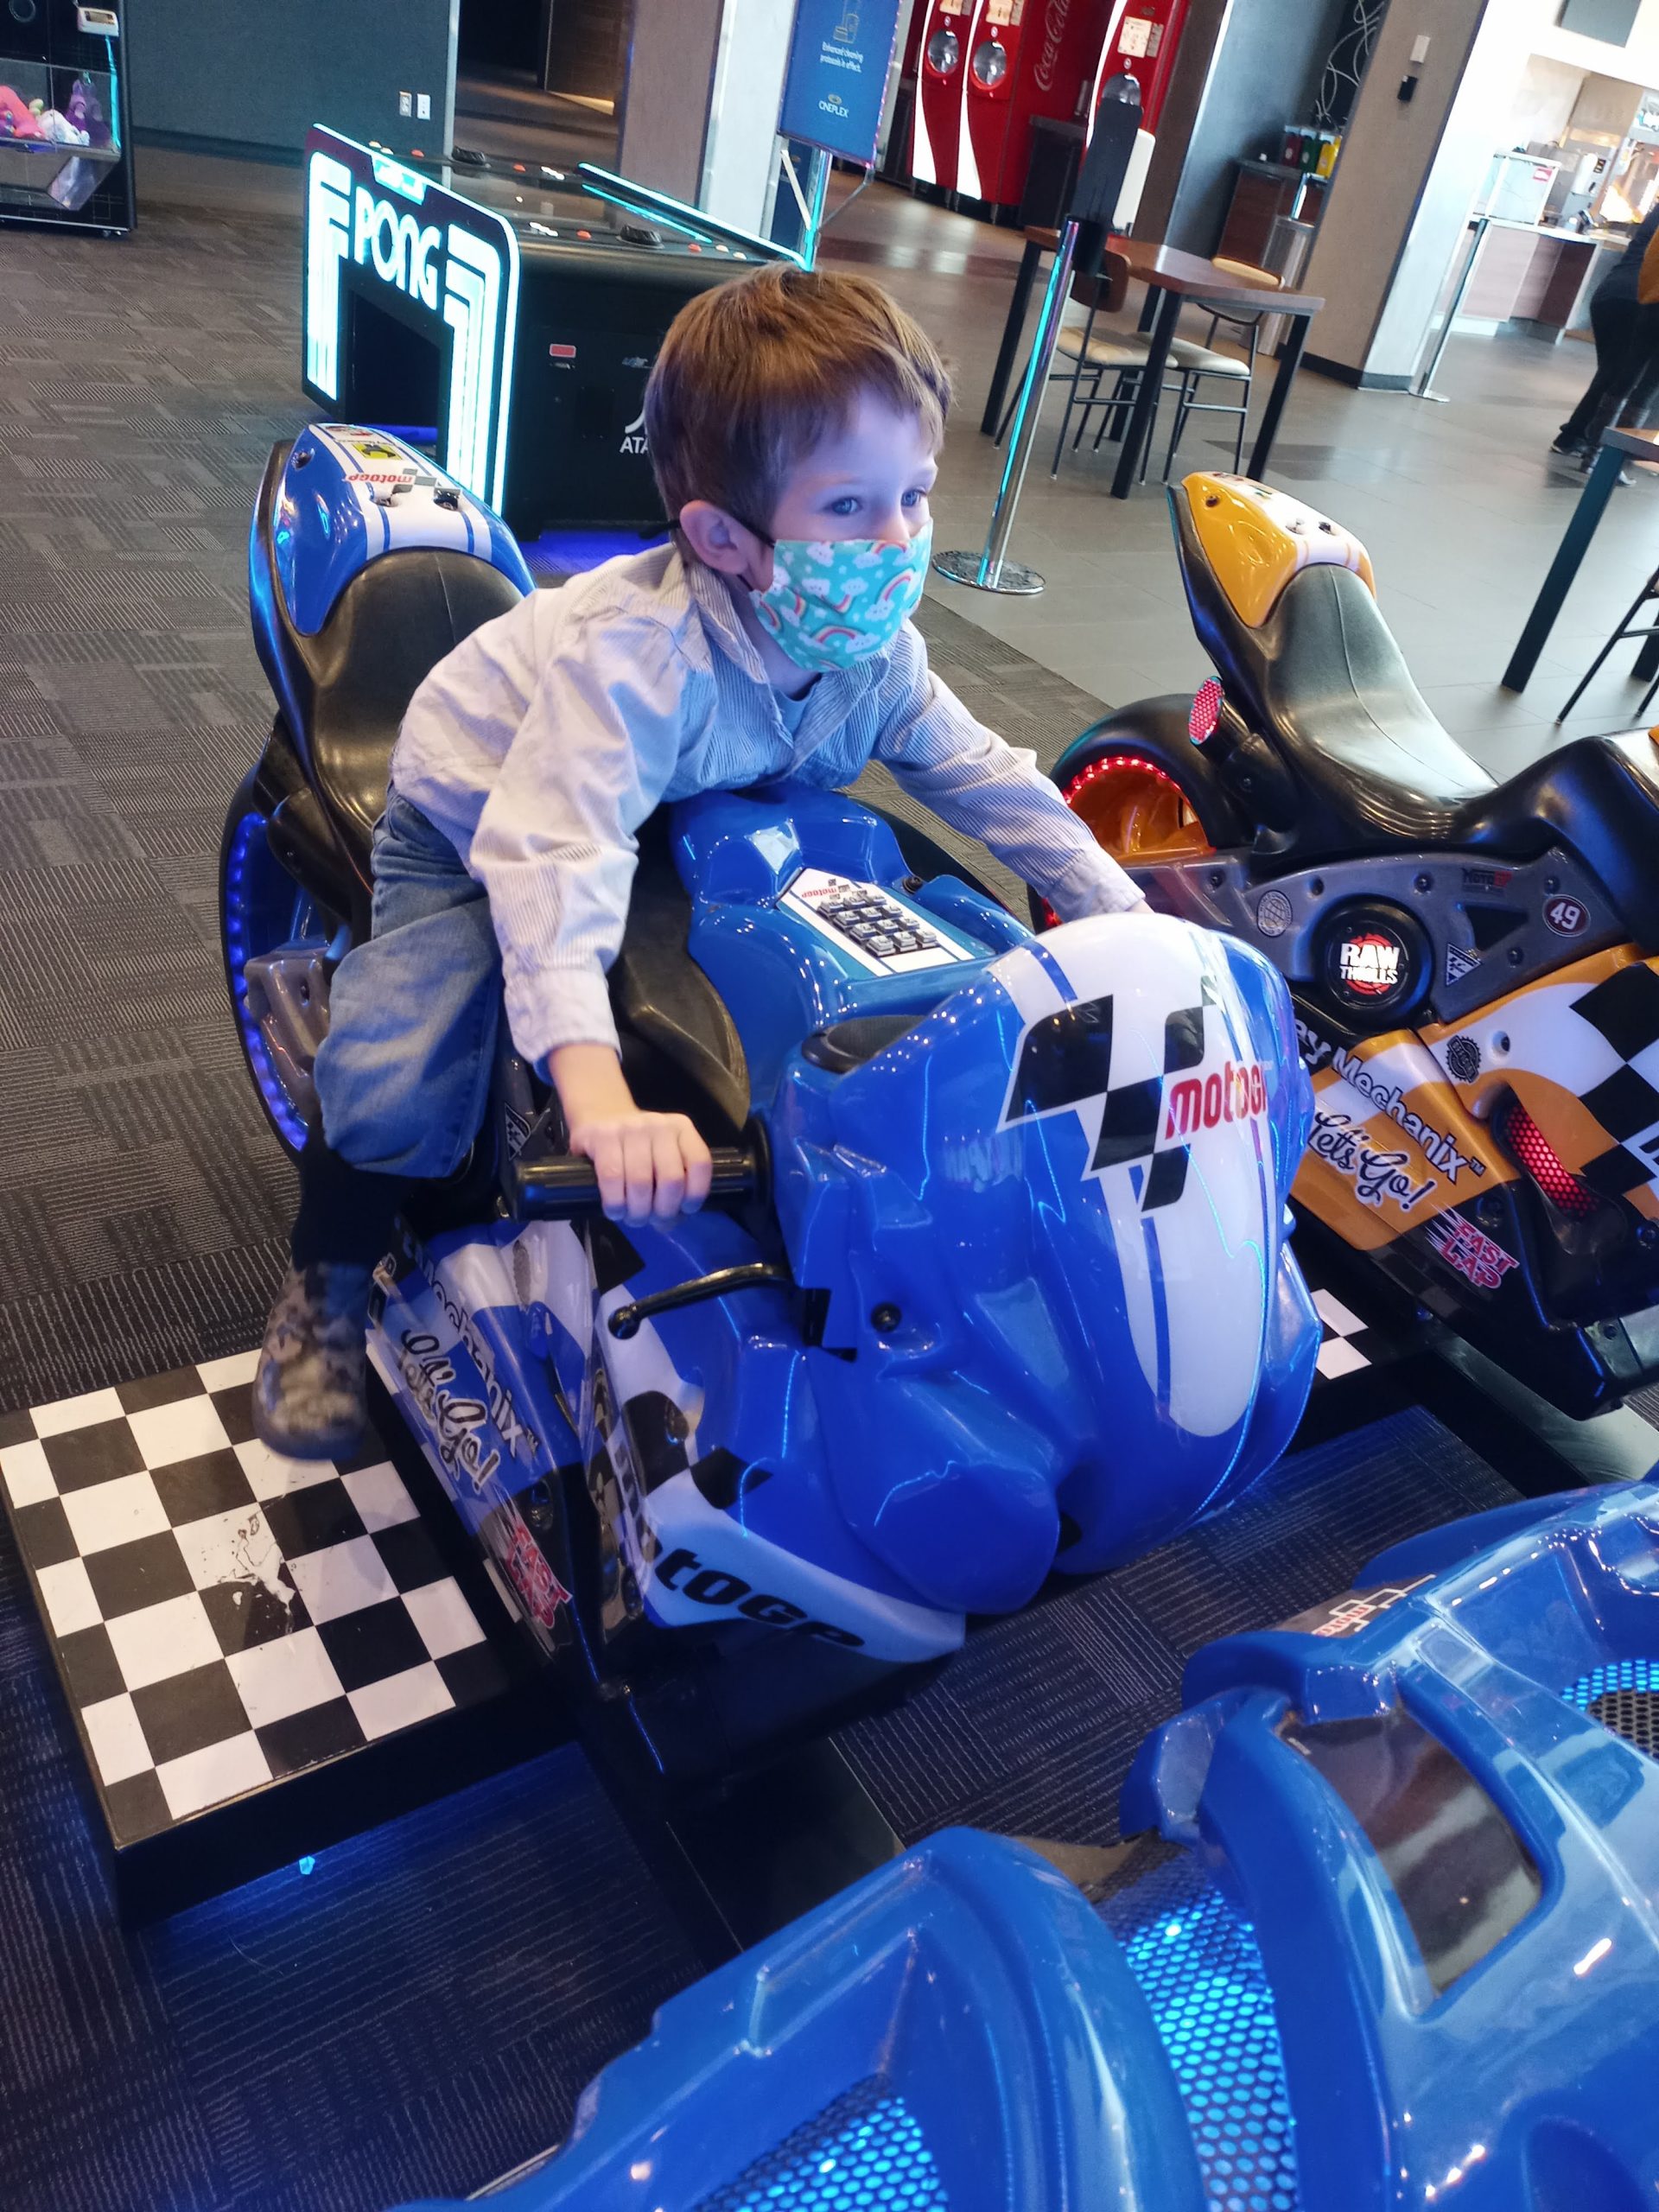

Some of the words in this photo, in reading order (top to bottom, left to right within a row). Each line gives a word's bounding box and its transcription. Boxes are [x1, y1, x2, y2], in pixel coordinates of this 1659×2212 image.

[818, 99, 849, 118] CINEPLEX
[353, 186, 443, 310] PONG
[619, 435, 650, 454] ATA
[1549, 901, 1581, 931] 49
[1340, 943, 1400, 969] RAW
[1332, 1046, 1468, 1186] Mechanix
[1356, 1149, 1437, 1211] Go!
[1440, 1236, 1502, 1289] LAP
[1453, 1219, 1521, 1276] FAST
